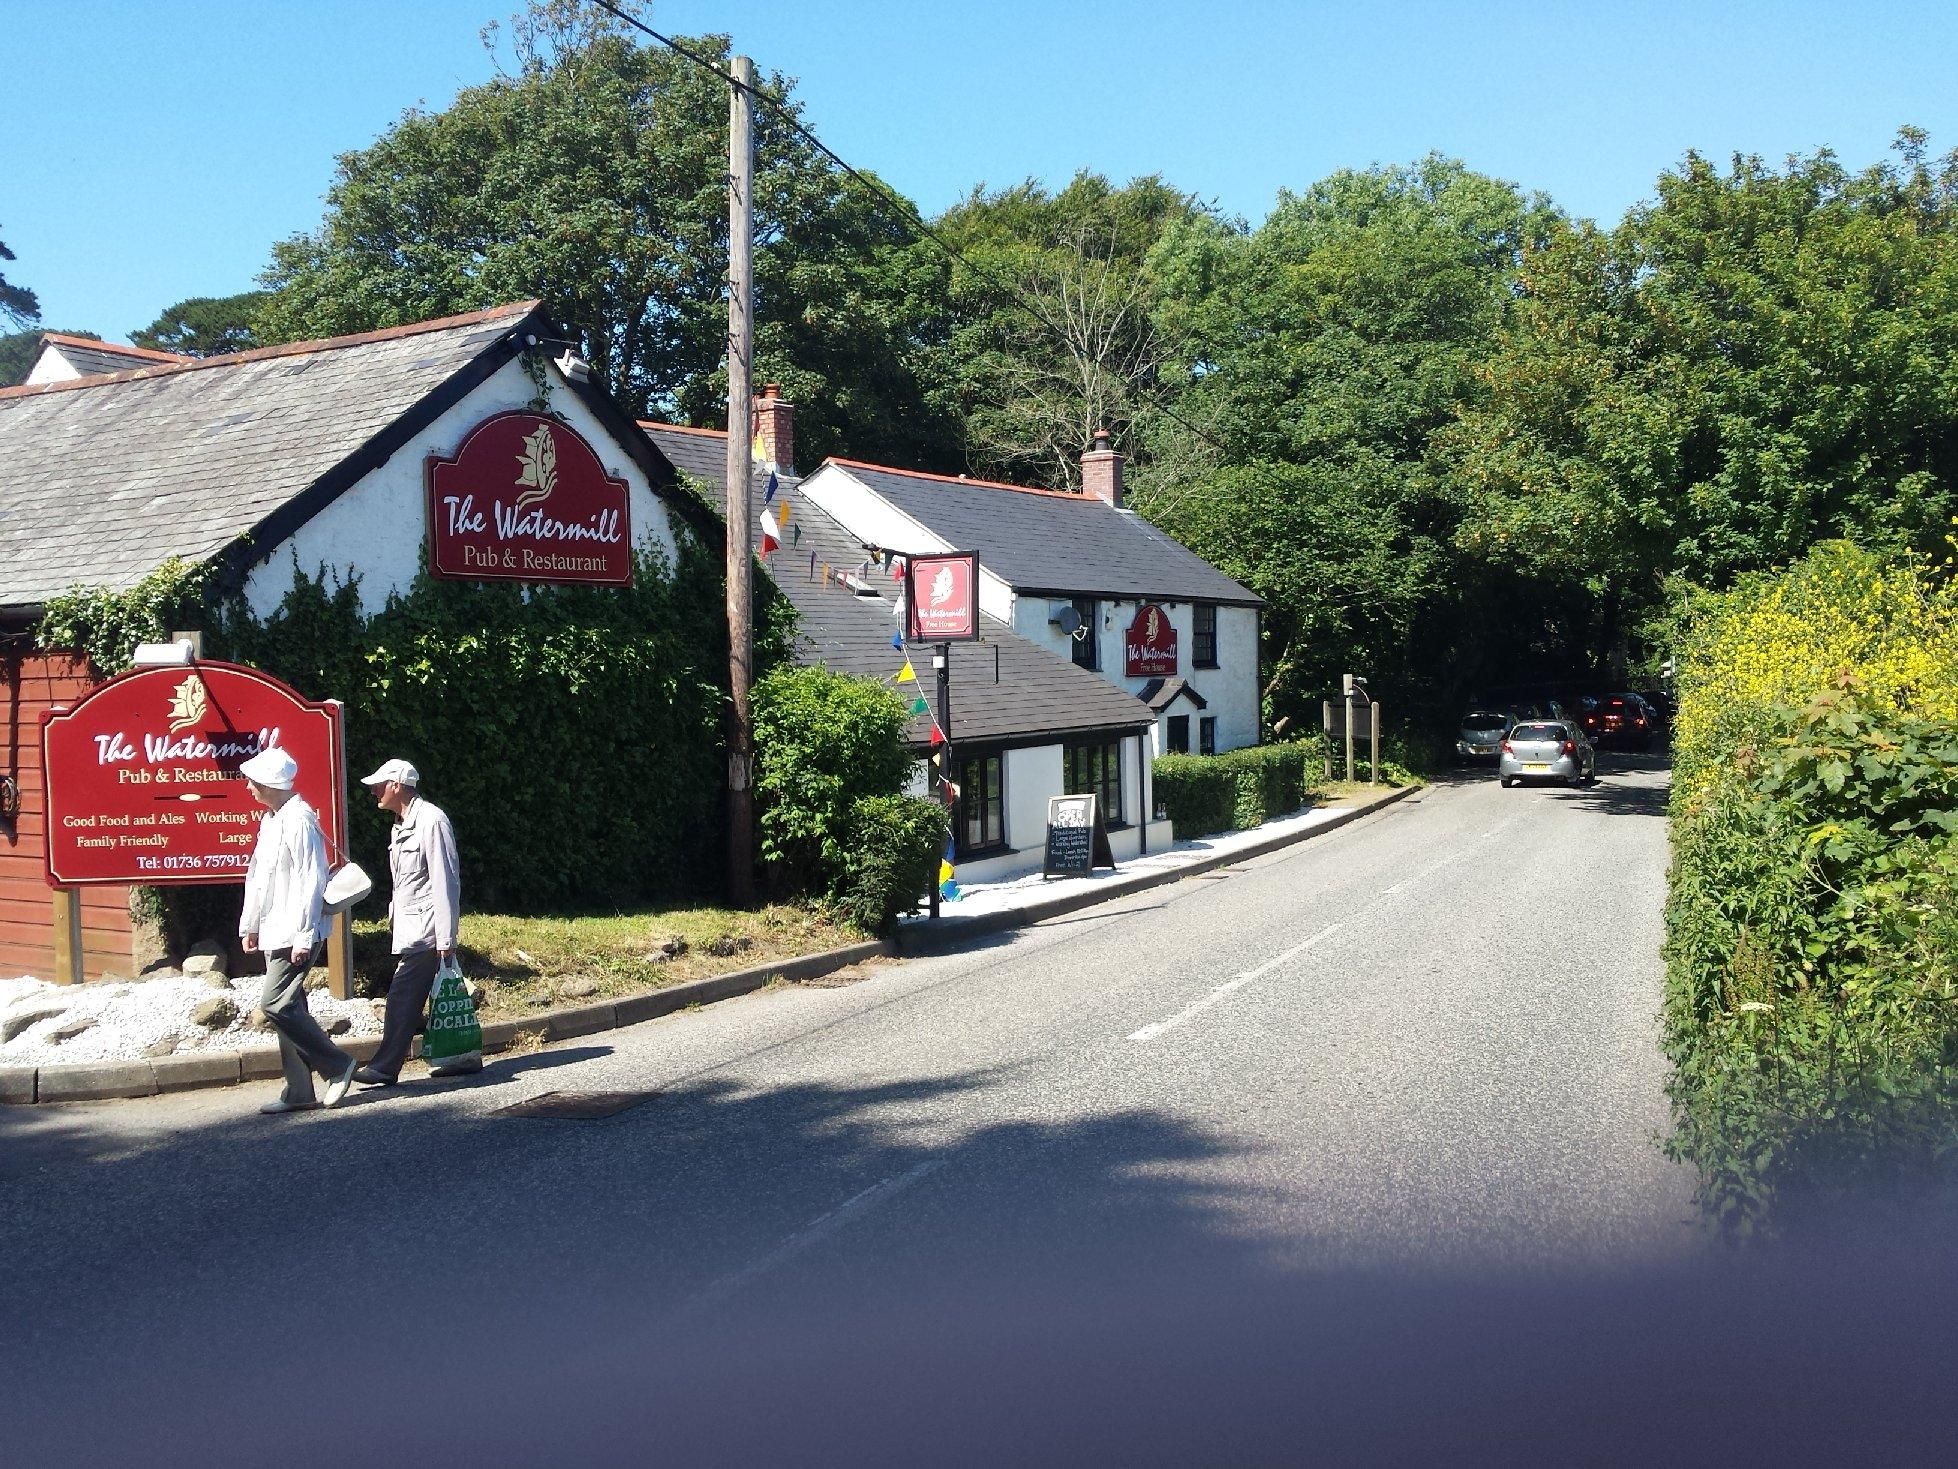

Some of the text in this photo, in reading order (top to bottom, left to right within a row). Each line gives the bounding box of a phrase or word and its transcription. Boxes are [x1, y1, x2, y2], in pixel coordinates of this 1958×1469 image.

[443, 494, 622, 543] The Watermill
[464, 545, 608, 572] Pub & Restaurant
[1128, 644, 1177, 661] The Watermill
[94, 731, 137, 766] The
[118, 765, 244, 785] Pub & Restaura
[63, 815, 95, 828] Good
[99, 815, 129, 827] Food
[133, 814, 156, 826] and
[159, 812, 185, 825] Ales
[195, 811, 248, 827] Working
[76, 836, 117, 850] Family
[119, 834, 169, 848] Friendly
[219, 832, 253, 847] Large
[137, 854, 250, 869] Tel: 01736 757912
